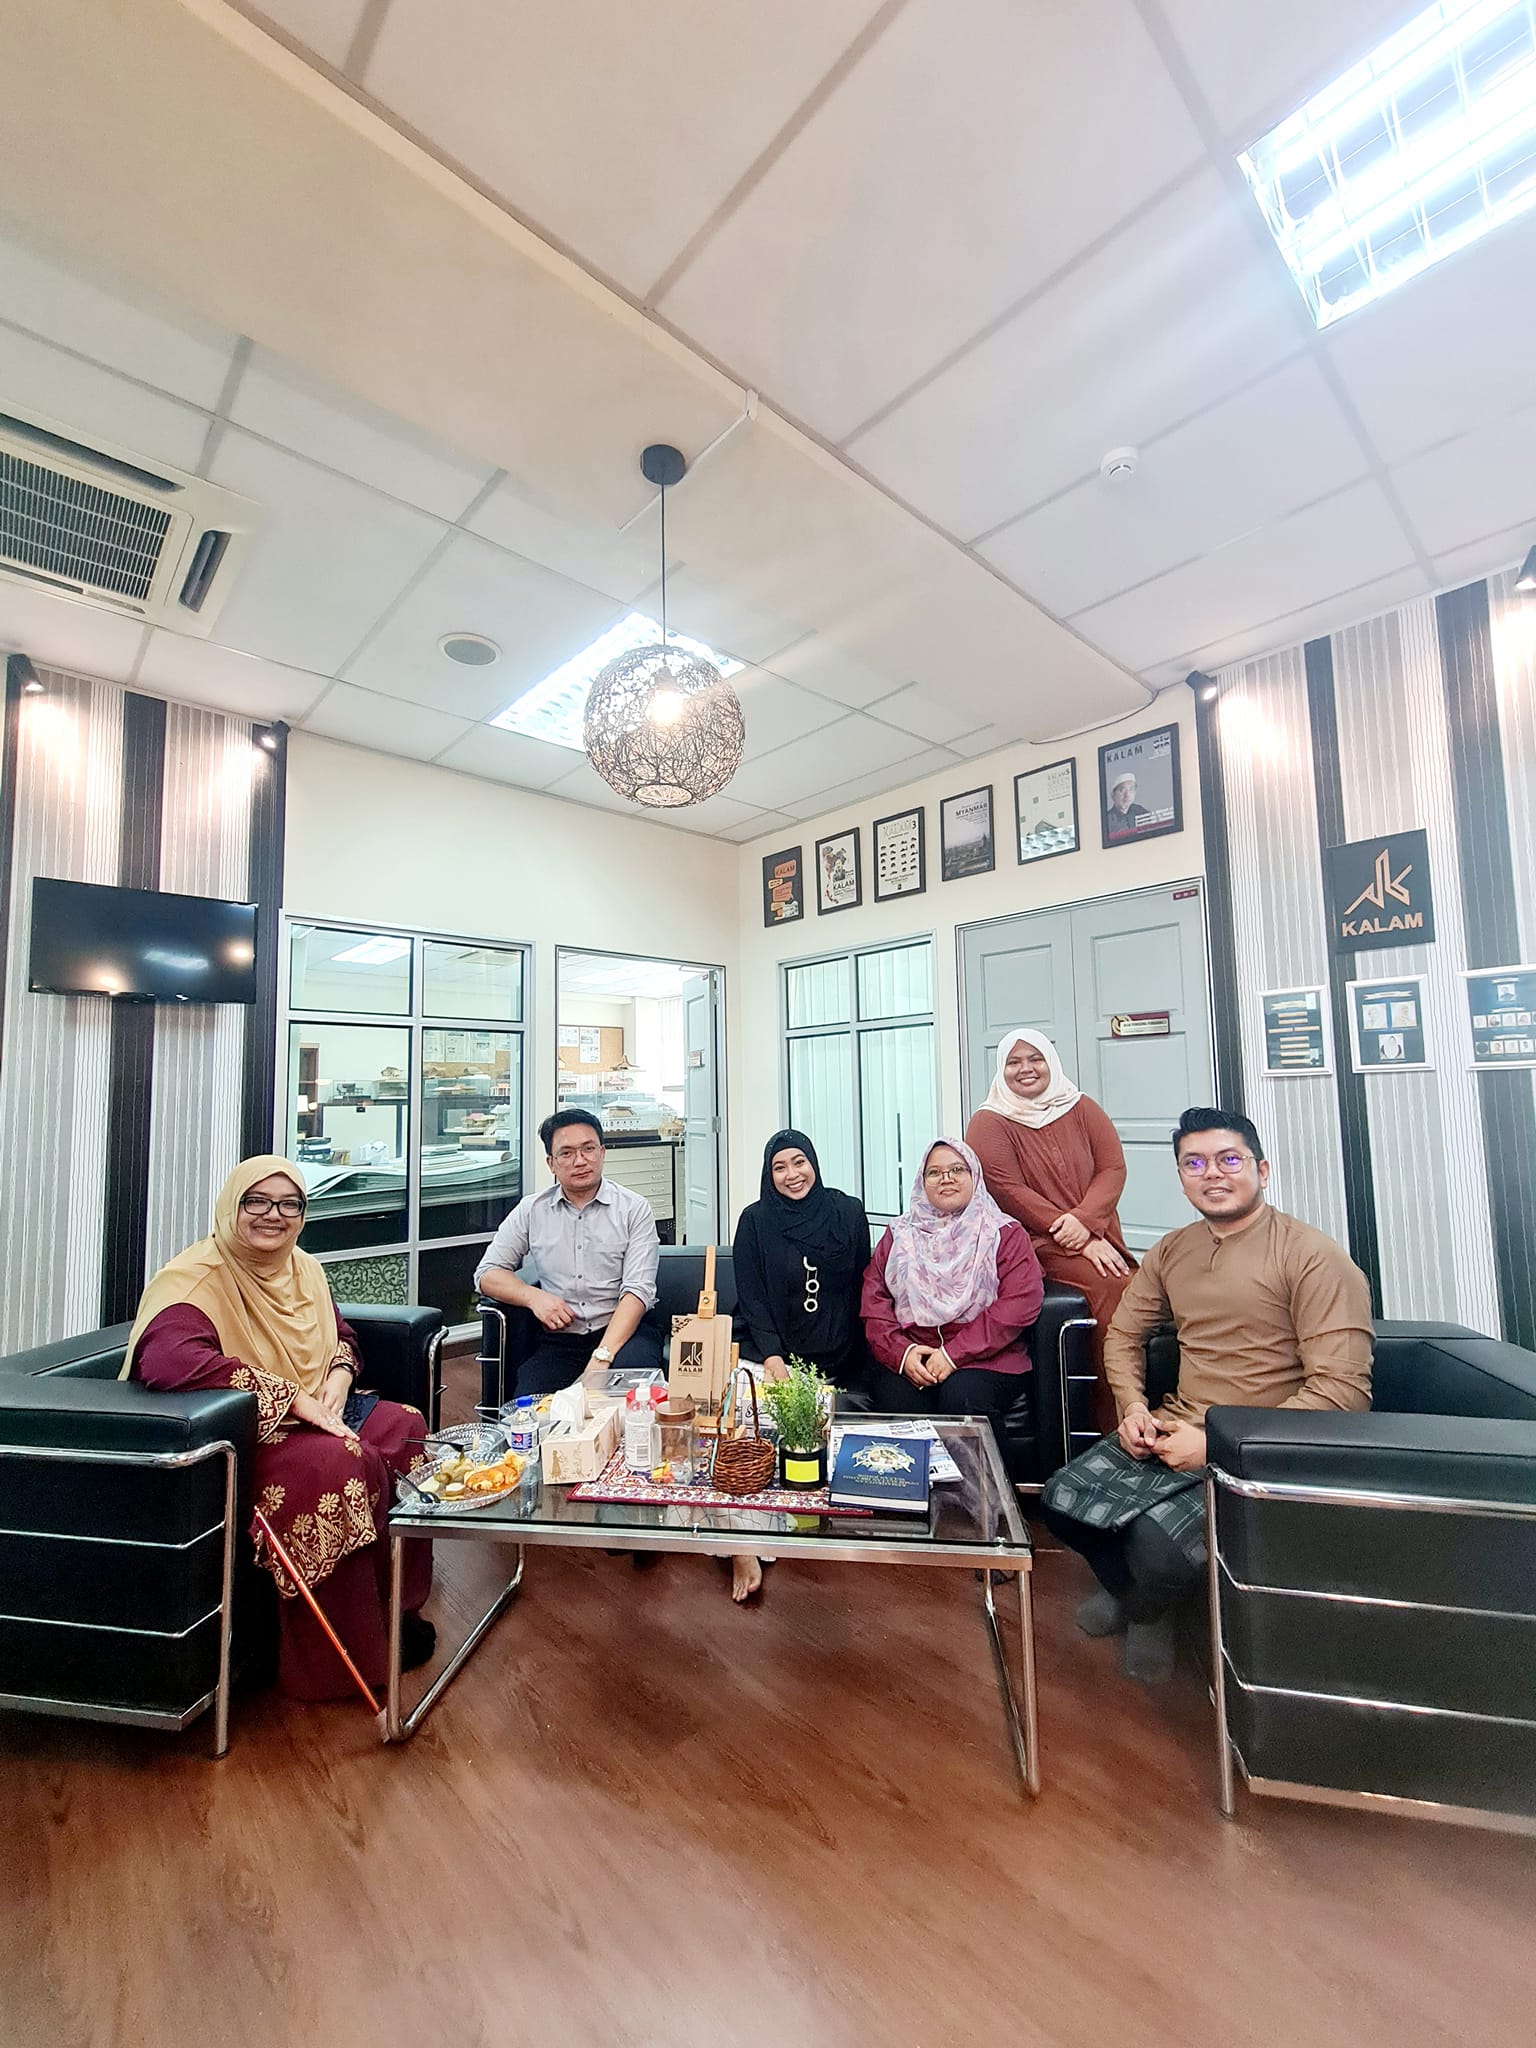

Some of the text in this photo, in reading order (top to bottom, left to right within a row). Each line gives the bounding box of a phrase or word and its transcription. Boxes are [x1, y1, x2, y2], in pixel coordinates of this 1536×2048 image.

[1106, 744, 1143, 763] KALAM
[955, 803, 987, 816] MYANMAR
[776, 865, 795, 875] KALAM
[833, 880, 855, 890] KALAM
[1342, 912, 1423, 937] KALAM
